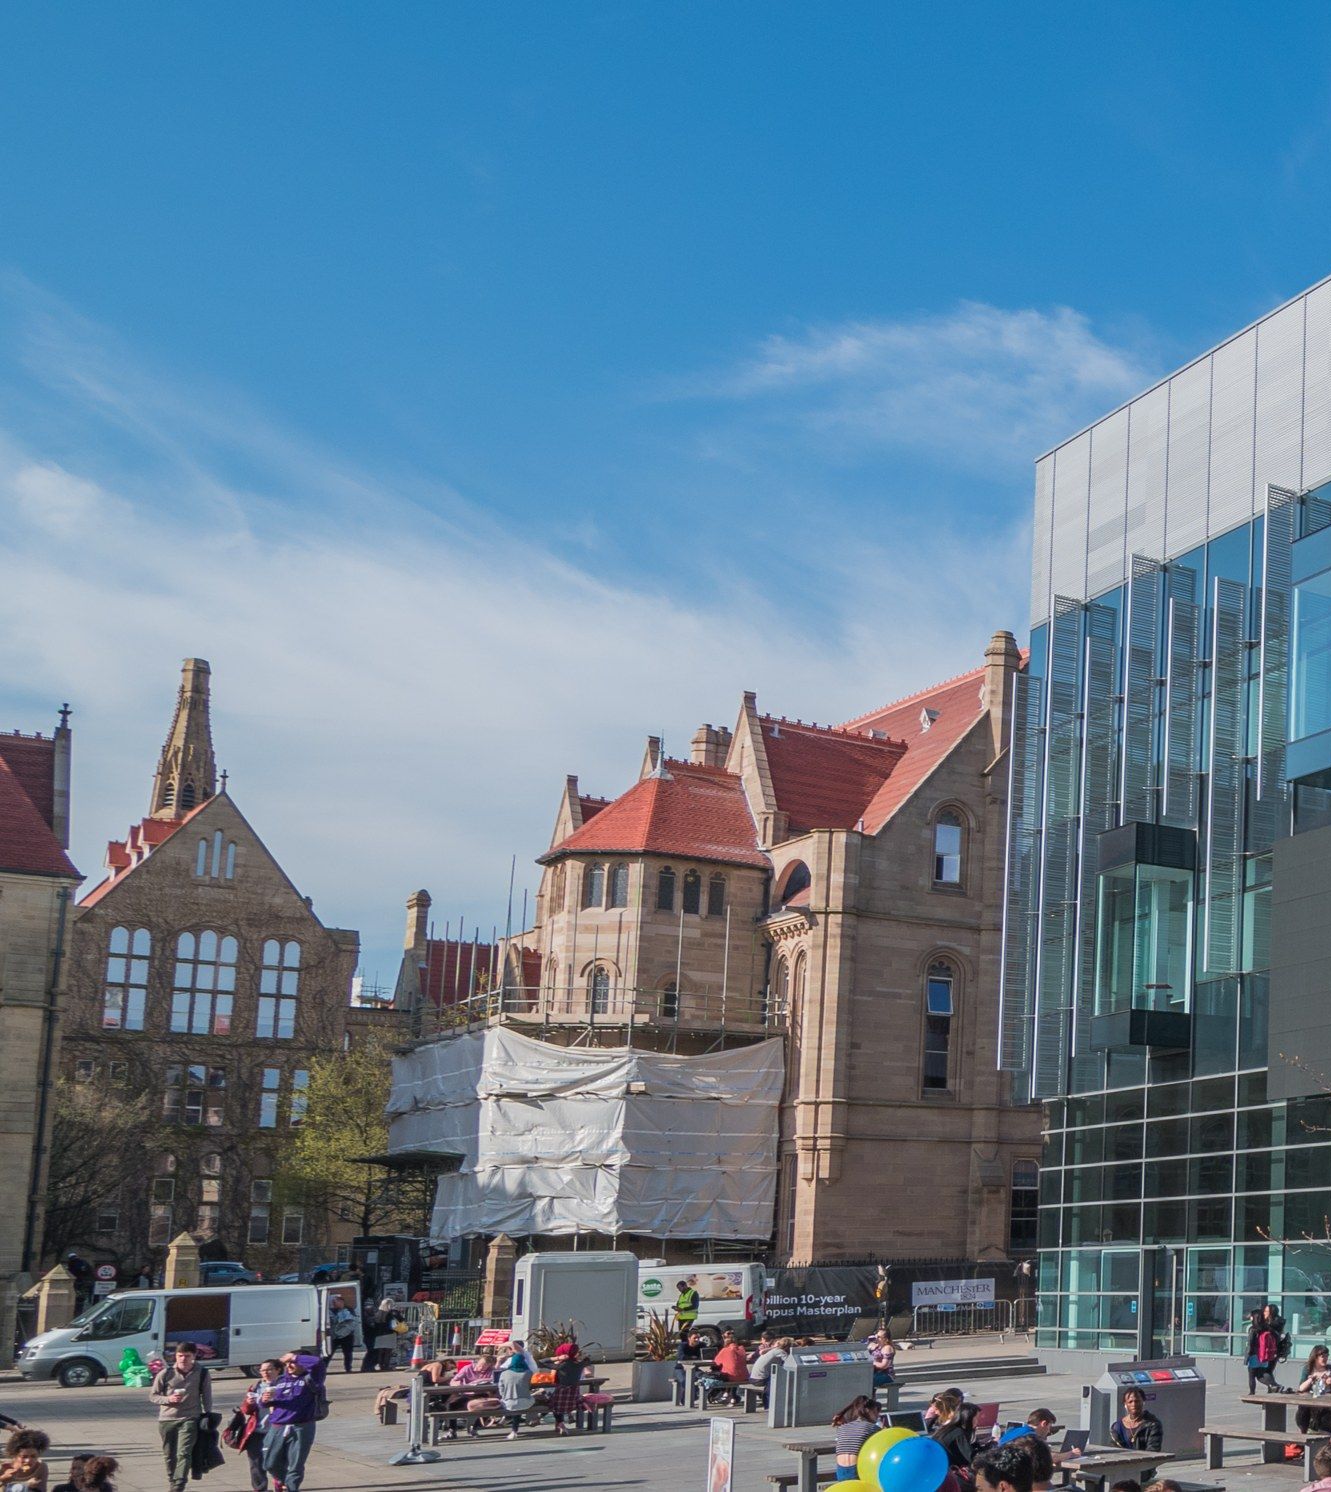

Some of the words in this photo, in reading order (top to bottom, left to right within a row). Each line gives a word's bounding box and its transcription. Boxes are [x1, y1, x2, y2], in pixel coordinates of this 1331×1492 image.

[917, 1284, 991, 1296] MANCHESTER
[800, 1294, 846, 1305] 10-year
[960, 1292, 977, 1301] 1824
[766, 1308, 795, 1318] mpus
[797, 1305, 862, 1316] Masterplan
